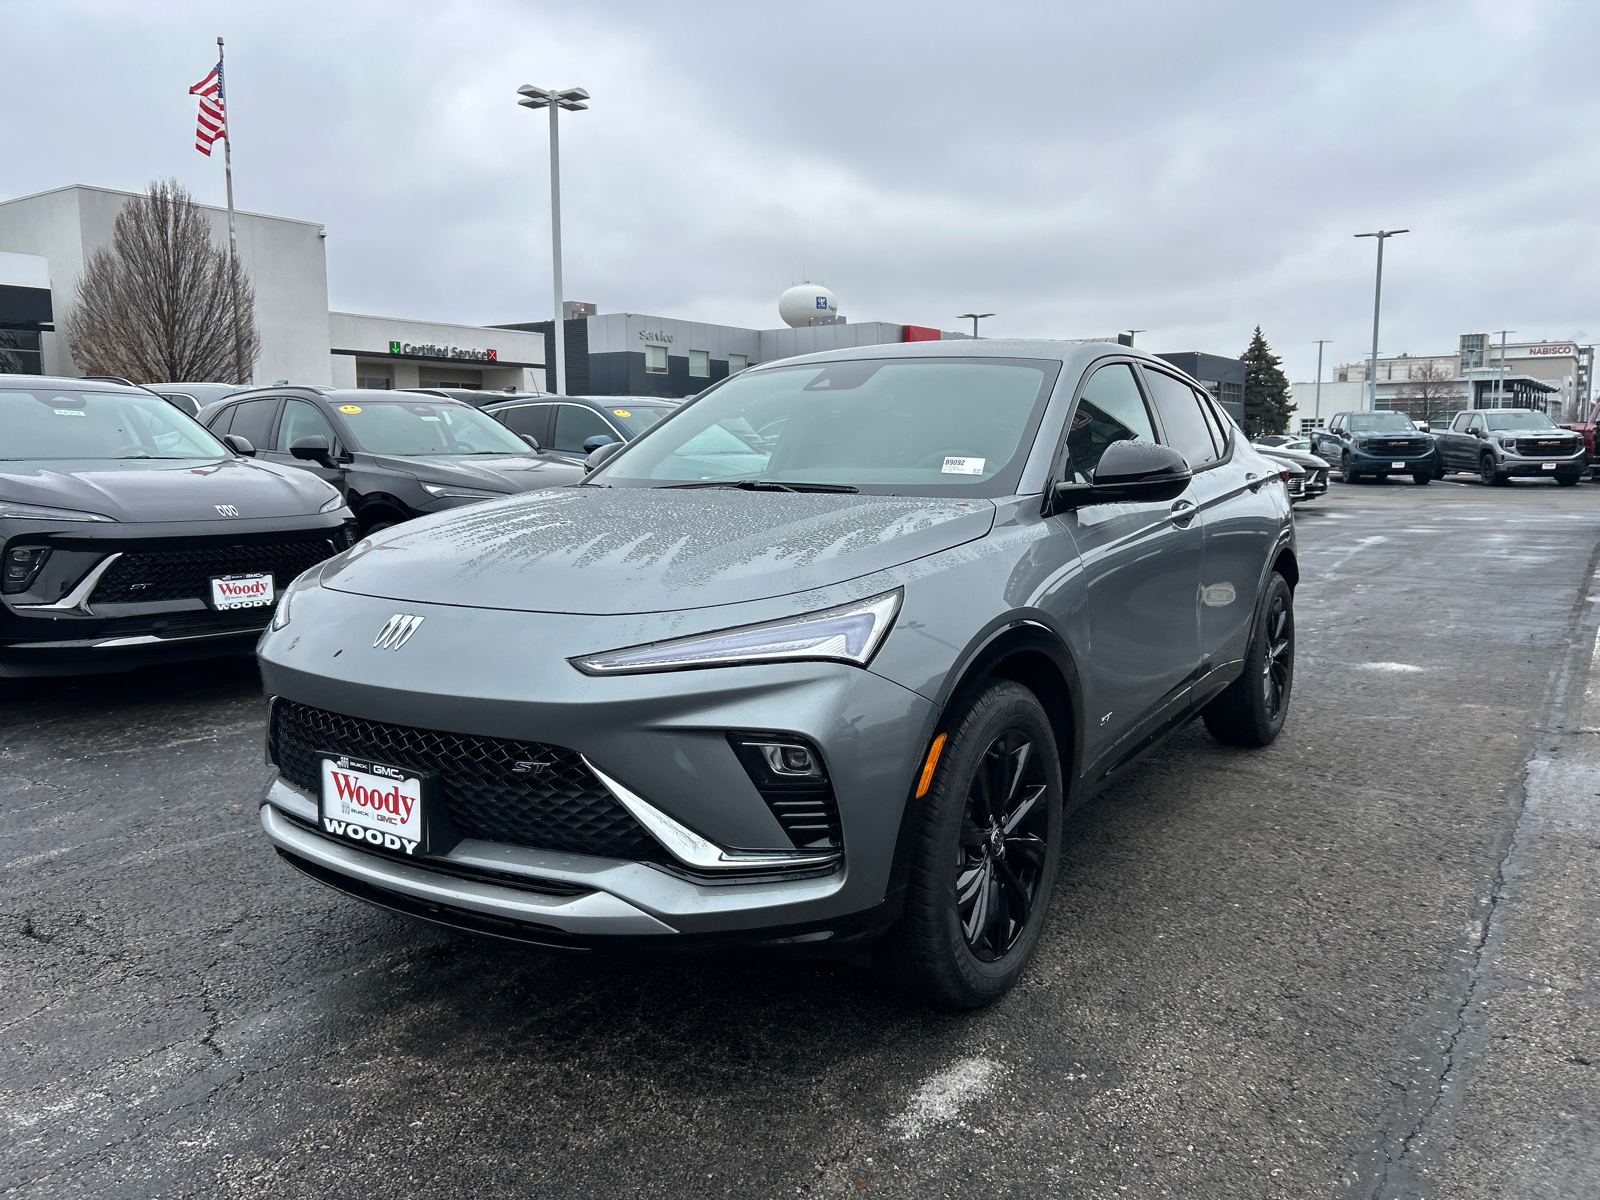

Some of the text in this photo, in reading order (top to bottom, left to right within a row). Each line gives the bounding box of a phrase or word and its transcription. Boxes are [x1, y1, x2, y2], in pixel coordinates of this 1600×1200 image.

[638, 330, 674, 343] Service
[402, 343, 488, 360] Certified Service
[1529, 346, 1572, 355] NABISCO
[217, 581, 268, 596] Woody
[217, 599, 273, 611] WOODY
[349, 761, 400, 777] BUICK GMC
[512, 761, 551, 774] ST
[330, 770, 416, 825] Woody
[350, 808, 398, 826] BUICK GMC
[323, 817, 418, 855] WOODY
